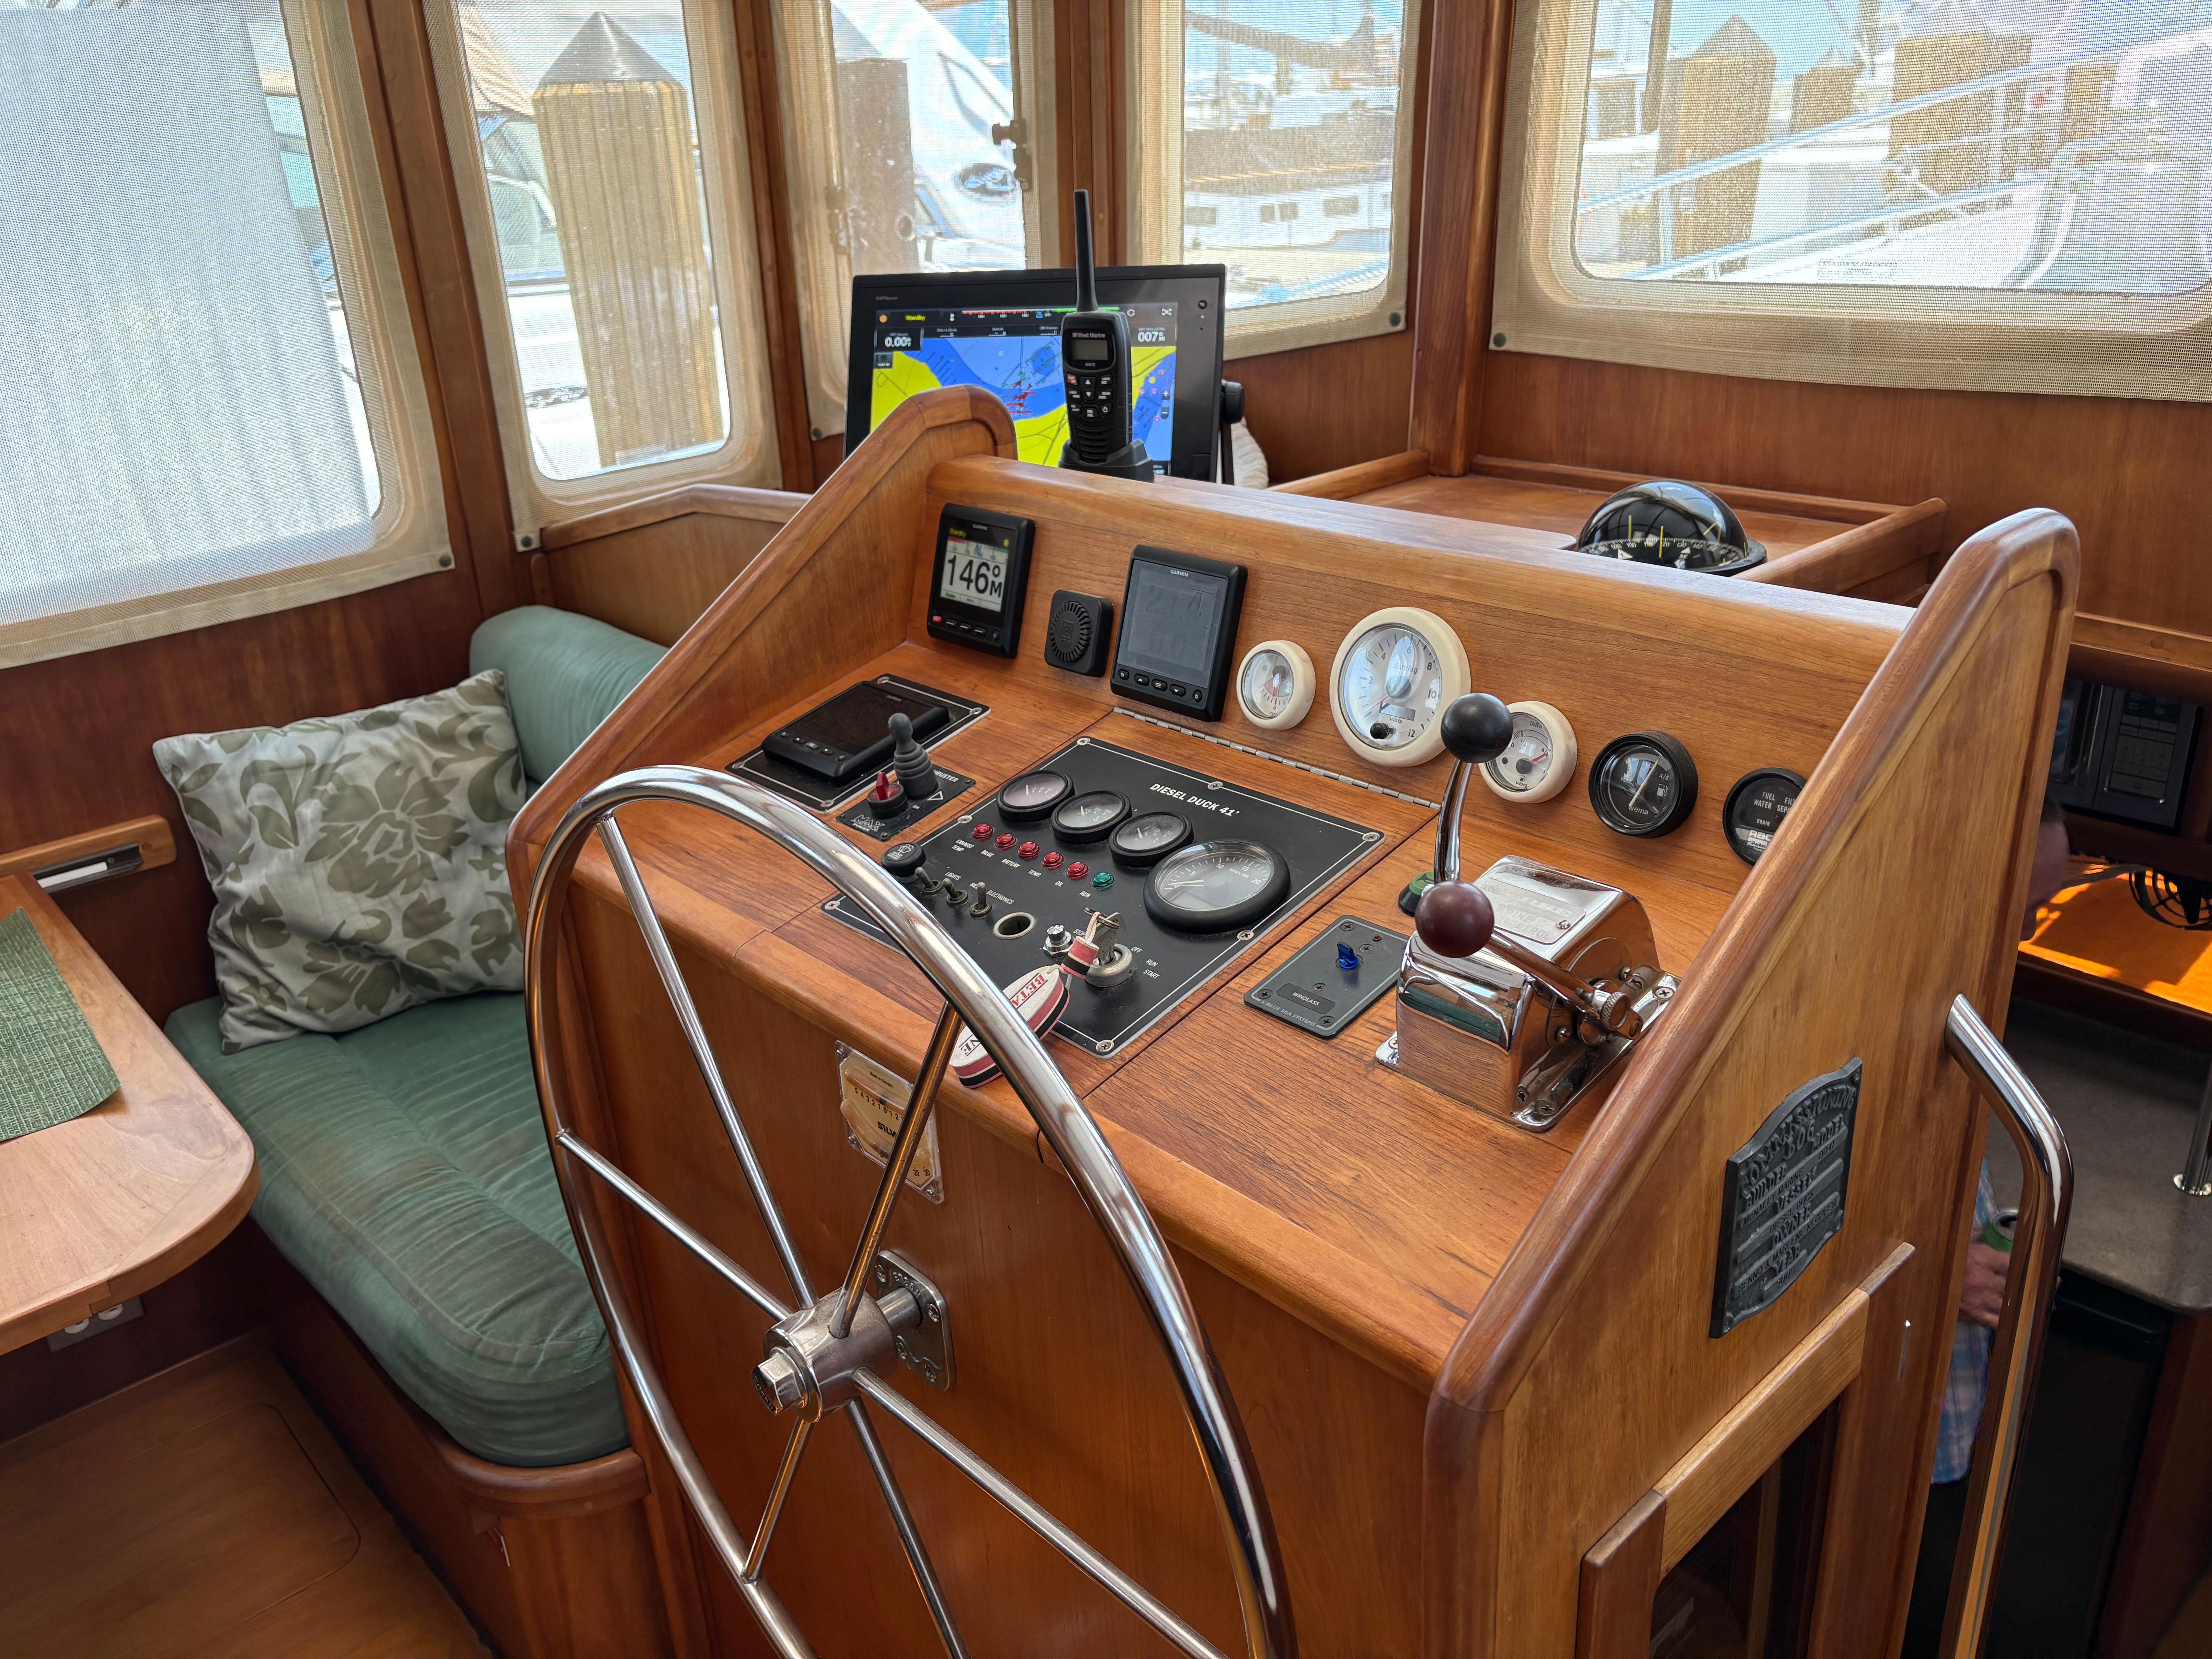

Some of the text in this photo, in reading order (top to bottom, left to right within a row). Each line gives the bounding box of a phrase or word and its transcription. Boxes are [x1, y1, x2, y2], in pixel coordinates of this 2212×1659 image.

[1170, 569, 1188, 577] GARMIN
[1407, 646, 1412, 654] 6
[1381, 653, 1386, 661] 4
[1393, 662, 1419, 675] Sumlog
[1427, 662, 1432, 671] 8
[1369, 676, 1373, 684] 2
[1428, 689, 1437, 699] 10
[1408, 728, 1416, 738] 12
[1659, 773, 1669, 781] 4/4
[1149, 783, 1240, 816] DIESEL DUCK 41'
[1762, 792, 1775, 801] FUEL
[1754, 799, 1772, 809] WATER
[1757, 818, 1770, 826] DRAIN
[852, 823, 870, 832] POWER
[955, 839, 975, 849] EXHAUST
[981, 850, 995, 858] BILGE
[1001, 858, 1021, 868] BATTERY
[945, 871, 961, 881] LIGHTS
[986, 890, 1015, 905] ELECTRONICS
[1146, 958, 1158, 967] RUN
[1143, 969, 1160, 979] START
[1012, 974, 1046, 1006] BETA
[1292, 991, 1321, 1006] WINDLASS
[1266, 1002, 1317, 1027] BLUE SEA SYSTEMS
[877, 1121, 897, 1137] SILV
[913, 1167, 930, 1177] 20 30
[1745, 1162, 1787, 1209] BUILDER
[1773, 1202, 1811, 1247] OWNER
